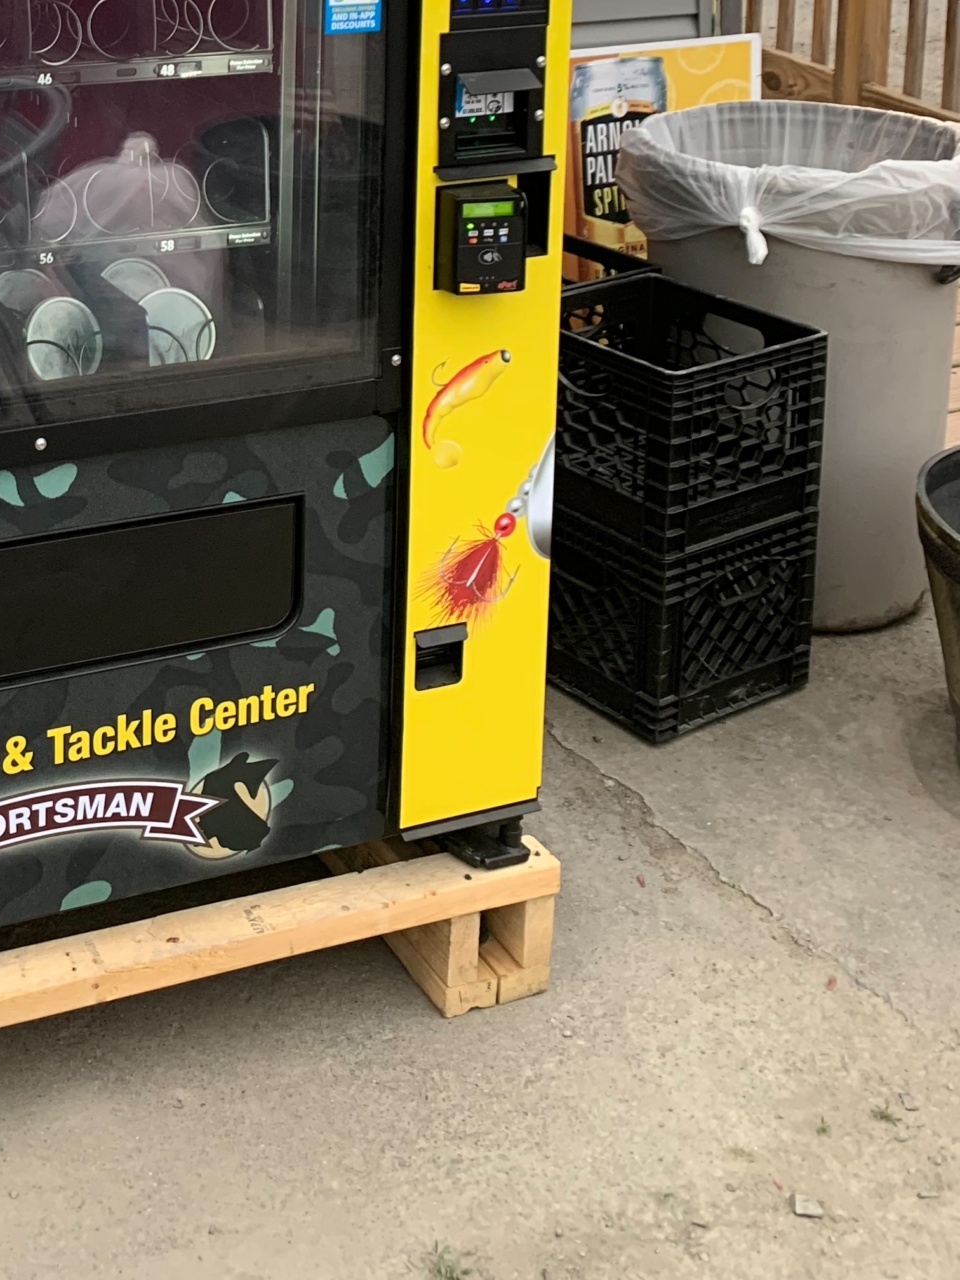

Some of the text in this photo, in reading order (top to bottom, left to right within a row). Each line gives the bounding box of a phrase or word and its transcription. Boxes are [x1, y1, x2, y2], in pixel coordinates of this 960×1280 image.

[331, 20, 376, 30] DISCOUNTS
[160, 64, 175, 76] 48
[38, 73, 53, 86] 46
[160, 240, 175, 252] 58
[39, 252, 54, 264] 56
[1, 734, 34, 776] &
[46, 703, 177, 765] Tackle
[189, 682, 315, 737] Center
